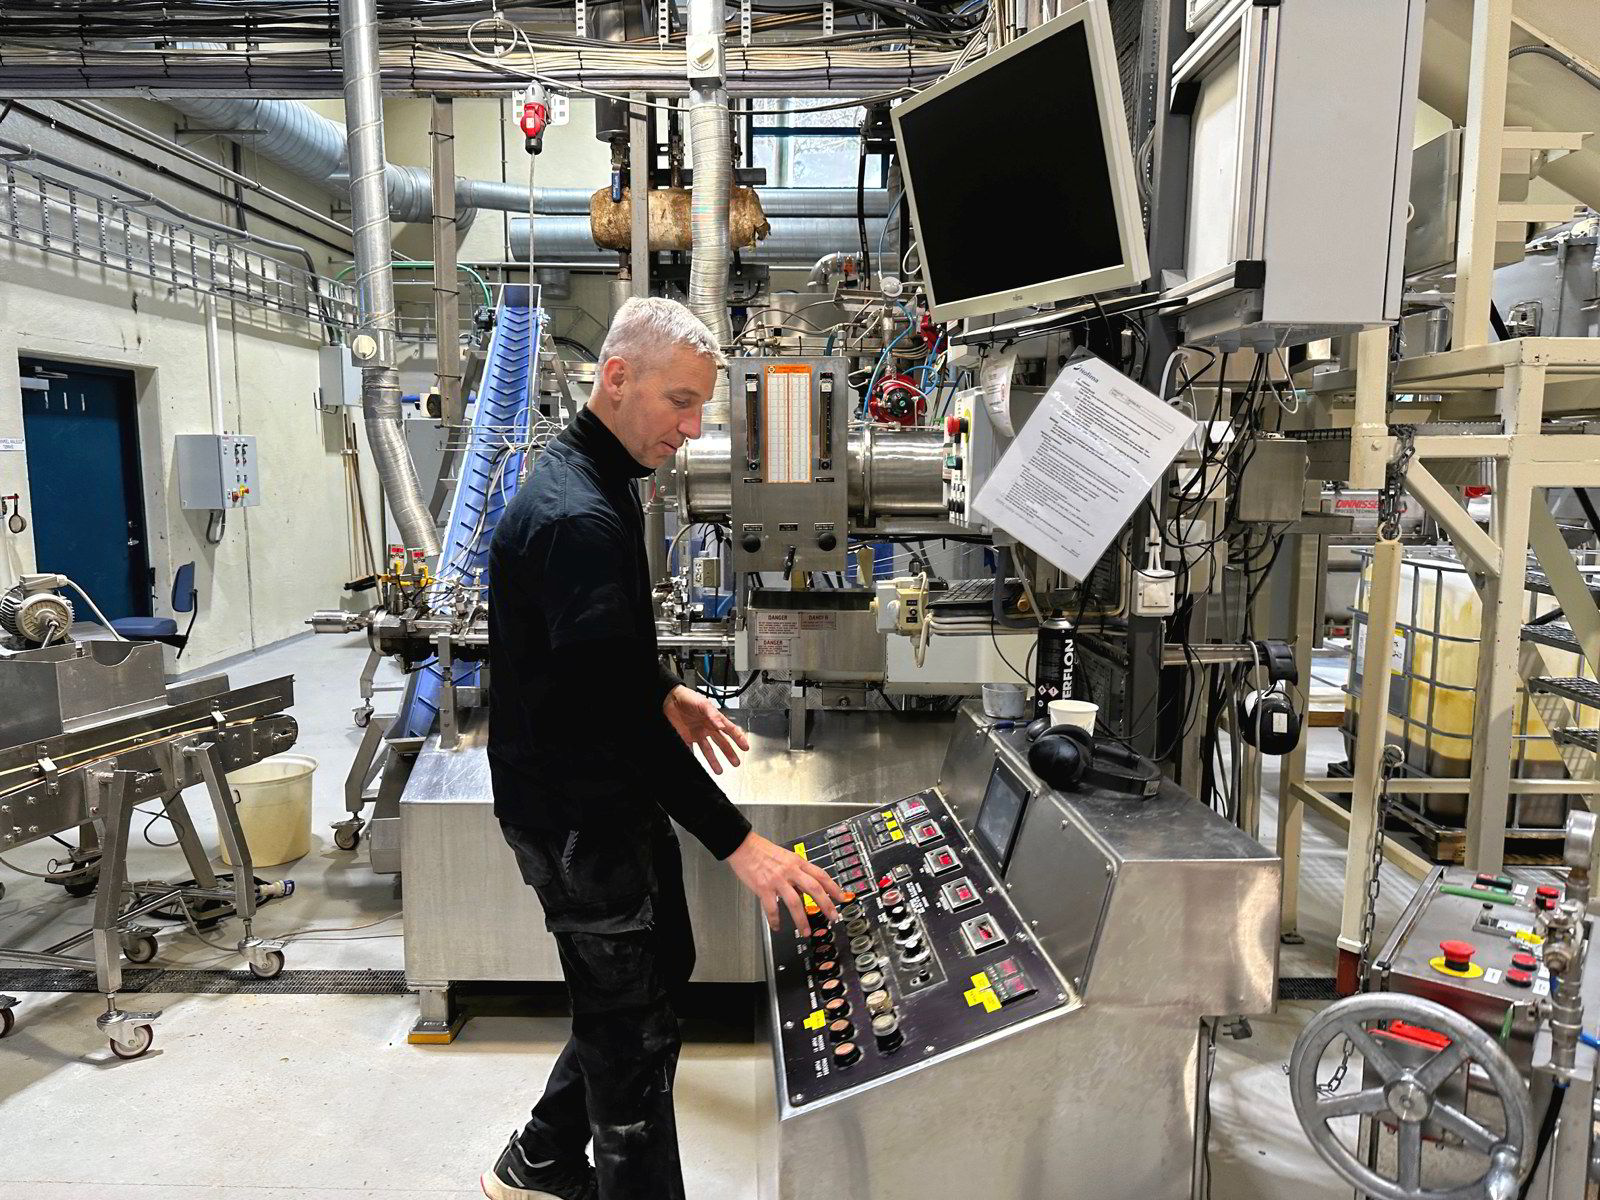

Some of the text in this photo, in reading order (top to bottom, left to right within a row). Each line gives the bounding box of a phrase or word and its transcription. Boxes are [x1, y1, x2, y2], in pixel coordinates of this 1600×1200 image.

[1080, 368, 1099, 384] Nofima
[1335, 500, 1386, 509] DINNISSE
[1062, 639, 1074, 700] ERFLON
